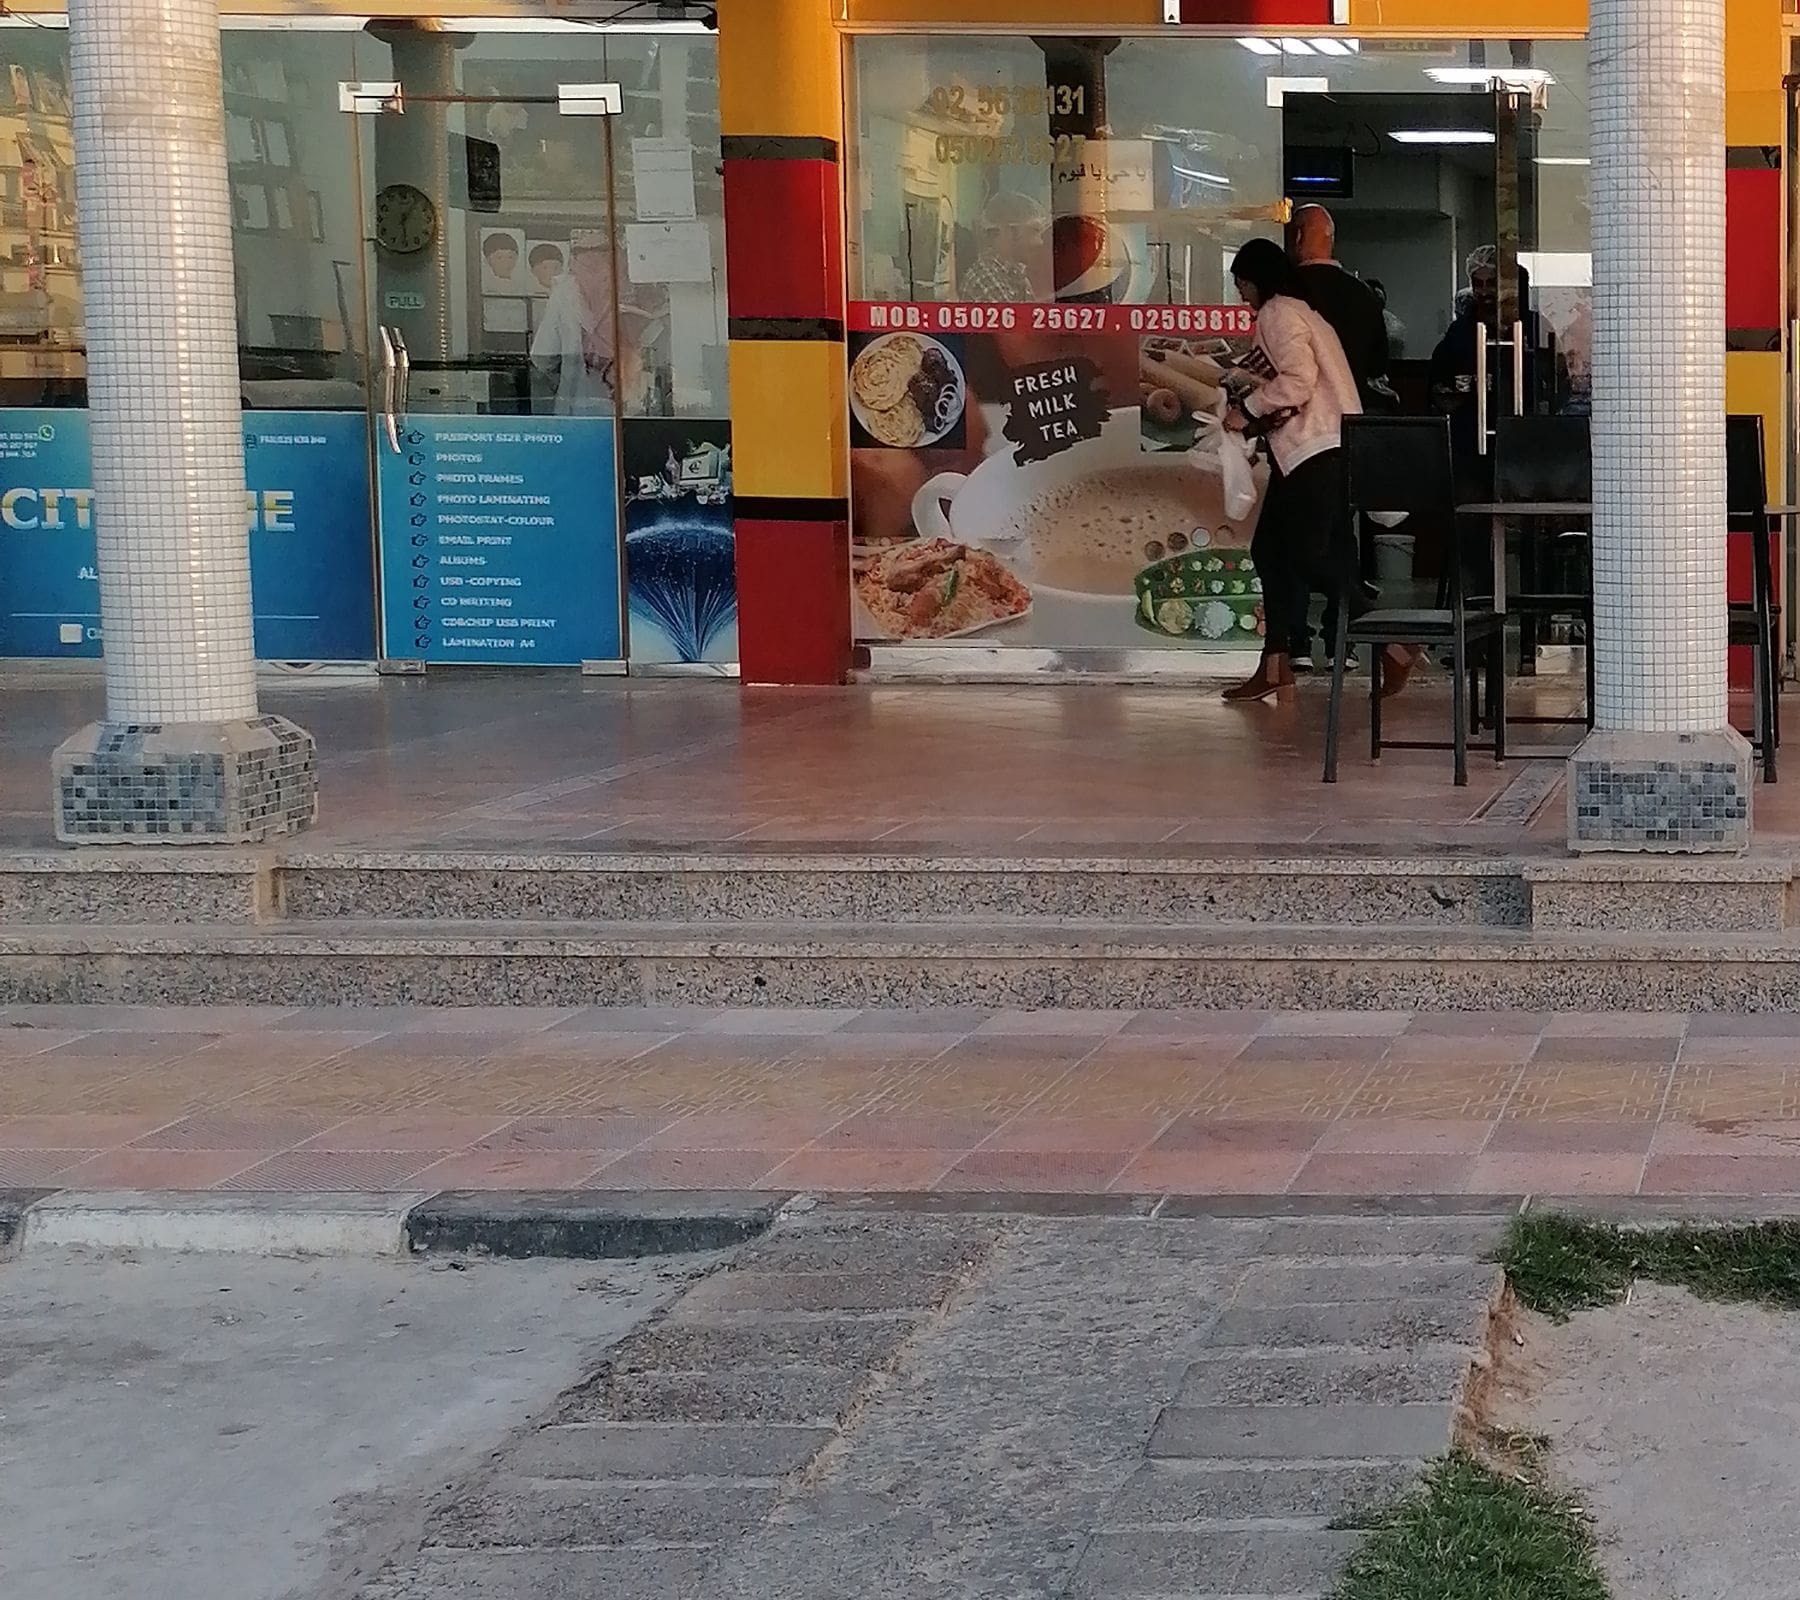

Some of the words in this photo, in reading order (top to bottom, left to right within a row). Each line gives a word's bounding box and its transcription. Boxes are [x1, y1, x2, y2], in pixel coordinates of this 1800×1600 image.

[870, 306, 929, 328] MOB:
[938, 307, 1015, 329] 05026
[1032, 308, 1107, 330] 25627
[1130, 309, 1252, 332] 02563813
[1013, 365, 1078, 396] FRESH
[1028, 392, 1077, 419] MILK
[1039, 419, 1078, 441] TEA
[524, 434, 563, 443] PHOTO
[436, 454, 482, 463] PHOTOS
[436, 473, 476, 483] PHOTO
[437, 495, 476, 504] PHOTO
[479, 495, 550, 505] LAMINATING
[1, 488, 95, 530] CIT
[439, 536, 475, 545] EMAIL
[477, 536, 512, 545] PRINT
